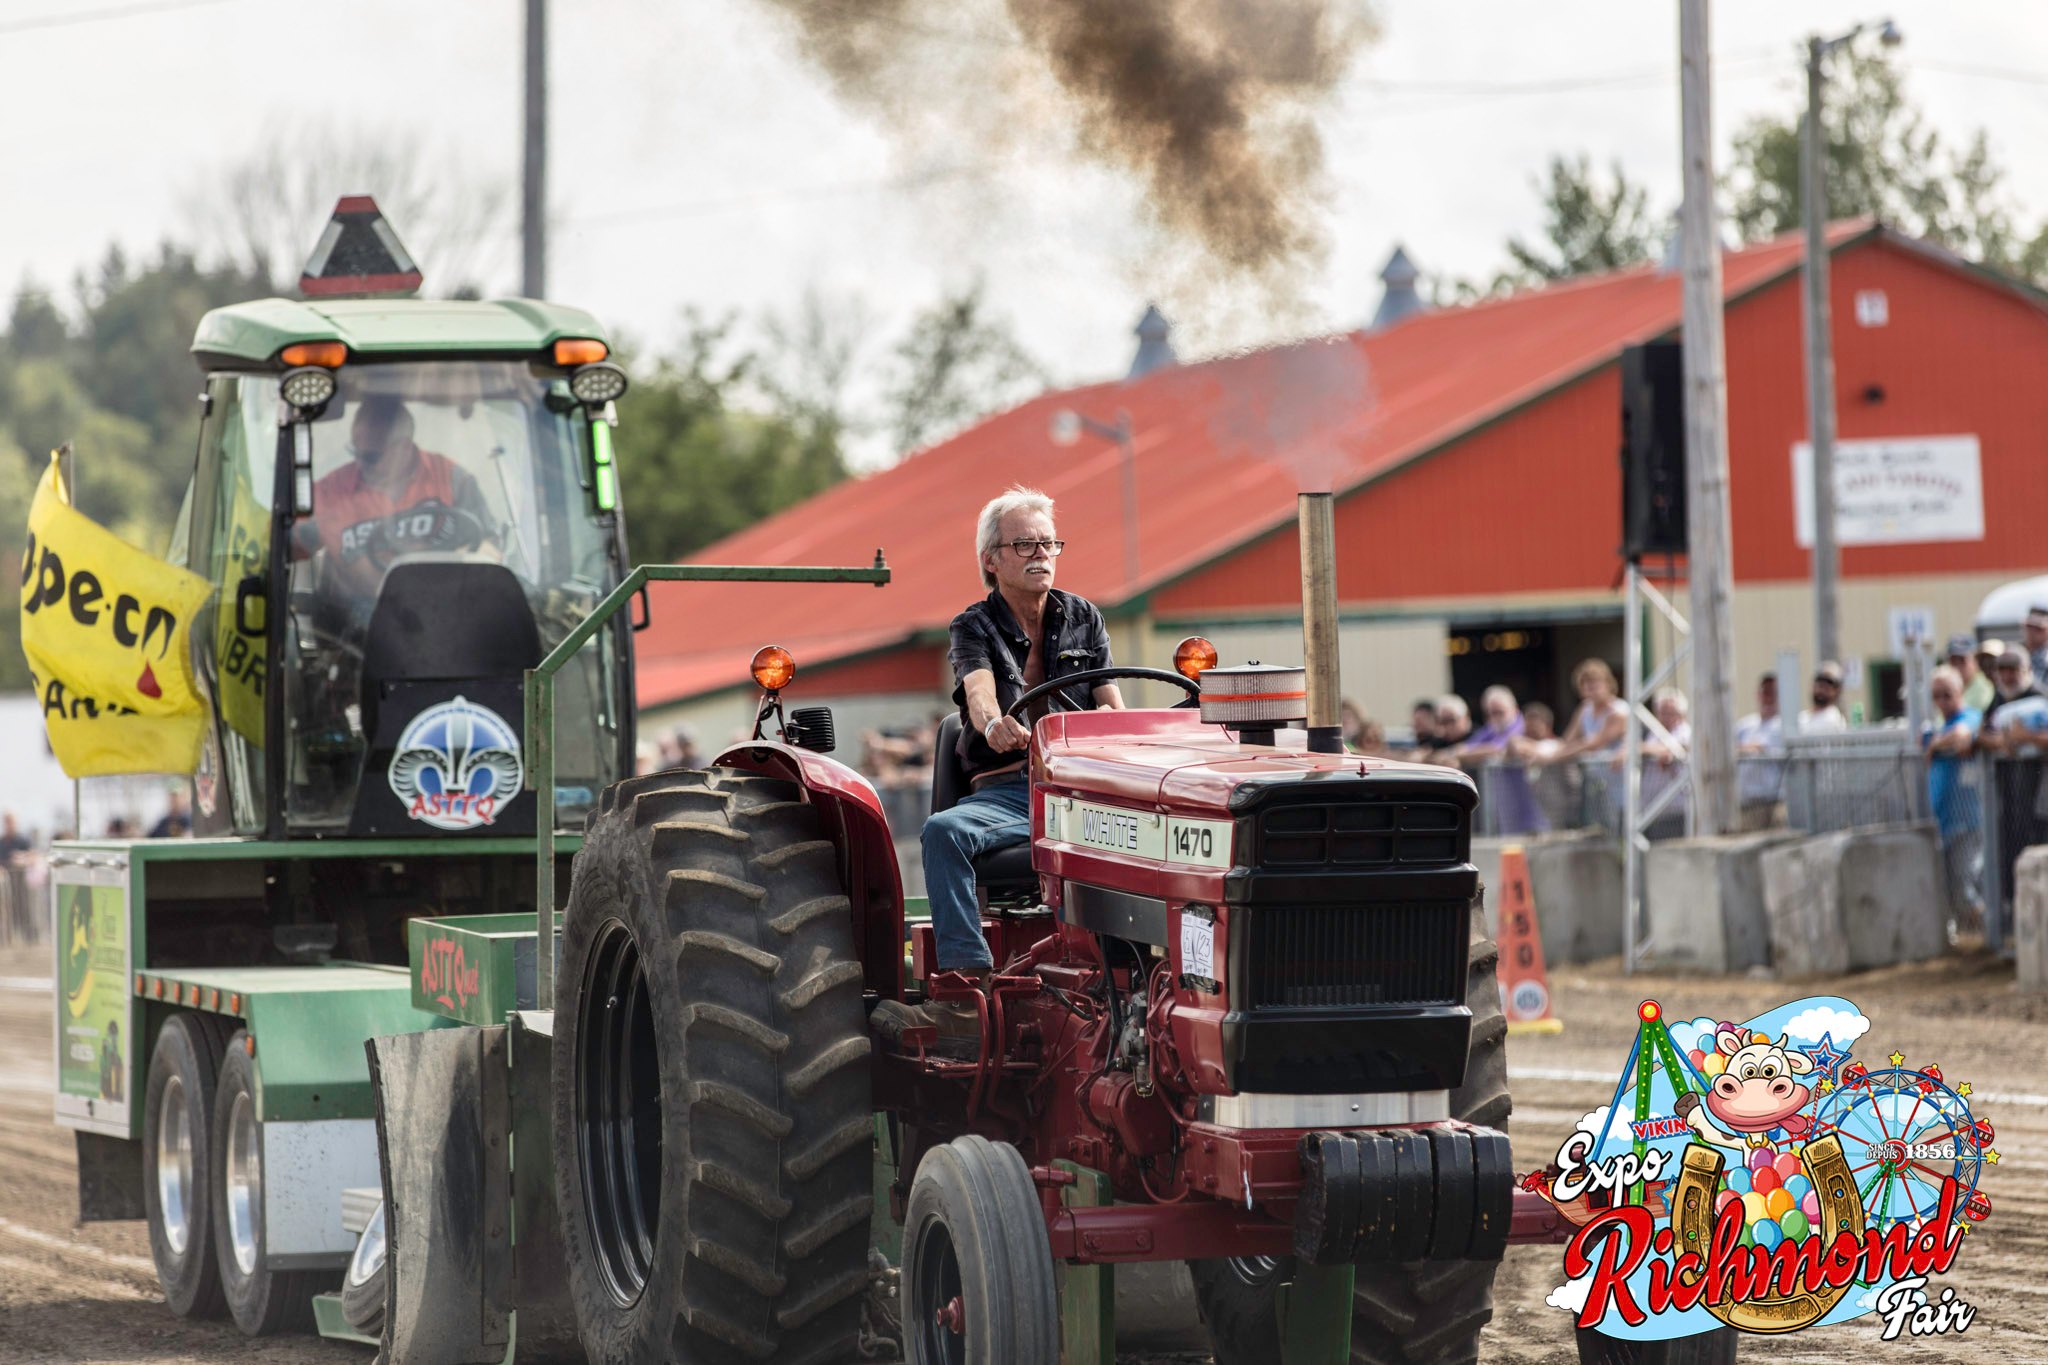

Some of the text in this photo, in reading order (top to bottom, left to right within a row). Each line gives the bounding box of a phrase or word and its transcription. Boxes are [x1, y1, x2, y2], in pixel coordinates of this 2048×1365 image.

[411, 792, 495, 824] ASTTQ
[1083, 808, 1138, 850] WHITE
[1173, 825, 1213, 858] 1470
